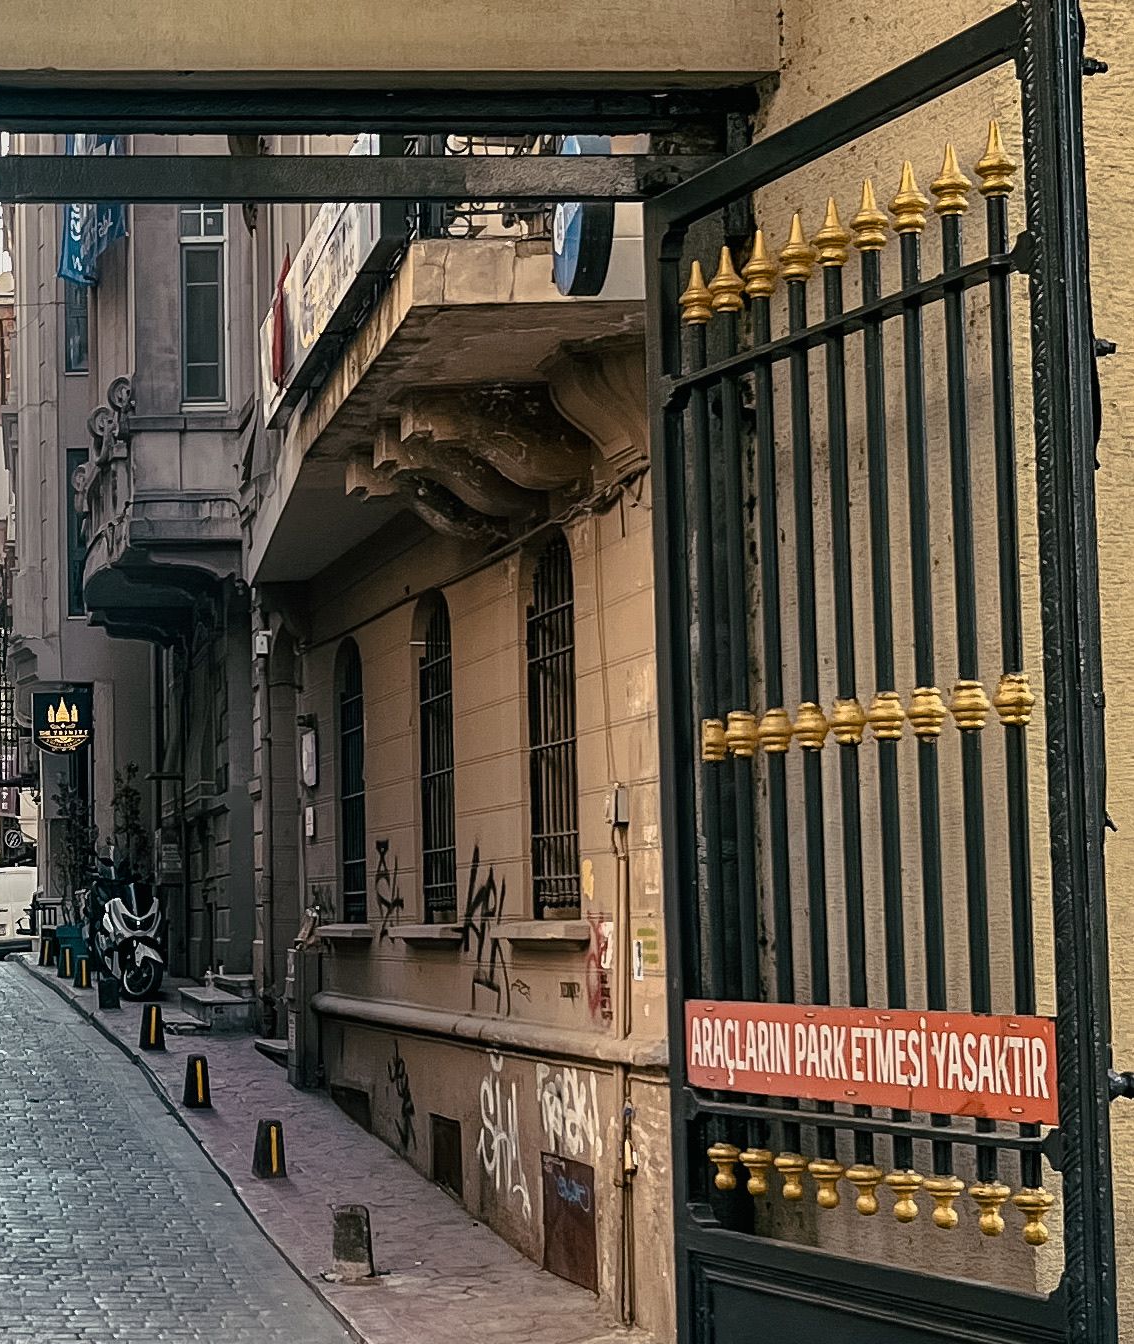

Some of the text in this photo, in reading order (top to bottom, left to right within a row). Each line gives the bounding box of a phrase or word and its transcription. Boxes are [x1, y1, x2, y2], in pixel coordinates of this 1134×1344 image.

[690, 1016, 1050, 1100] ARAÇLARIN PARK ETMESİ YASAKTIR
